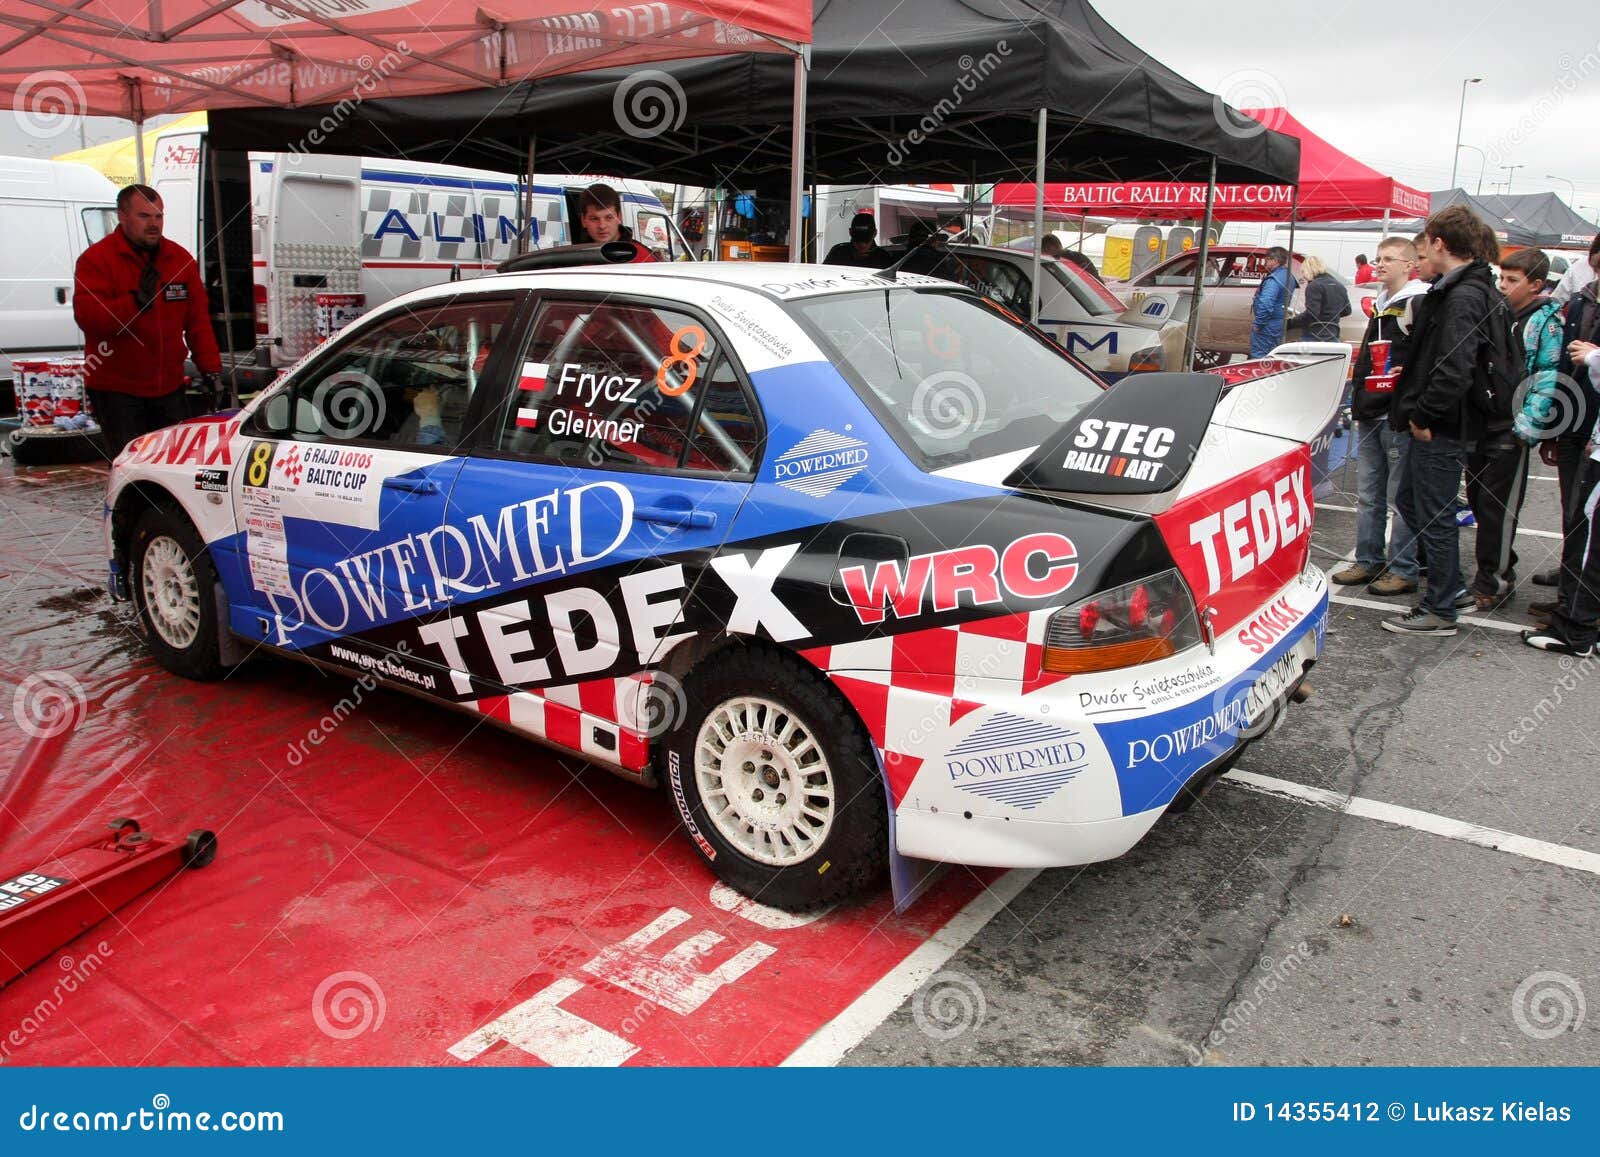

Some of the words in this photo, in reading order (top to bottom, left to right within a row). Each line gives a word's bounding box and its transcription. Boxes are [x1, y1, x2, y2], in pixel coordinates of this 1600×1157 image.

[1064, 186, 1124, 203] BALTIC
[1129, 186, 1185, 203] RALLY
[373, 208, 540, 246] ALIM
[657, 326, 706, 397] 8
[556, 363, 642, 408] Frycz
[1376, 380, 1393, 389] KFC
[548, 408, 644, 443] Gleixner
[1073, 418, 1175, 459] STEC
[201, 470, 221, 481] Frycz
[248, 442, 272, 487] 8
[304, 447, 313, 462] 6
[312, 448, 340, 465] RAJD
[339, 452, 374, 469] LOTOS
[307, 467, 342, 487] BALTIC
[344, 471, 368, 490] CUP
[775, 448, 868, 479] POWERMED
[1062, 450, 1111, 474] RALLI
[1124, 459, 1163, 482] ART
[201, 480, 228, 492] Gleixner
[1189, 465, 1312, 597] TEDEX
[266, 480, 635, 647] POWERMED
[838, 532, 1079, 625] WRC
[418, 542, 814, 696] TEDEX
[1238, 596, 1304, 654] SONAX
[330, 644, 436, 689] www.wrc.tedex.pl
[1079, 689, 1127, 708] Dwór
[1132, 664, 1216, 702] Świętoszówka
[1126, 698, 1243, 769] POWERMED
[946, 739, 1087, 781] POWERMED
[668, 750, 717, 862] BFGoodrich
